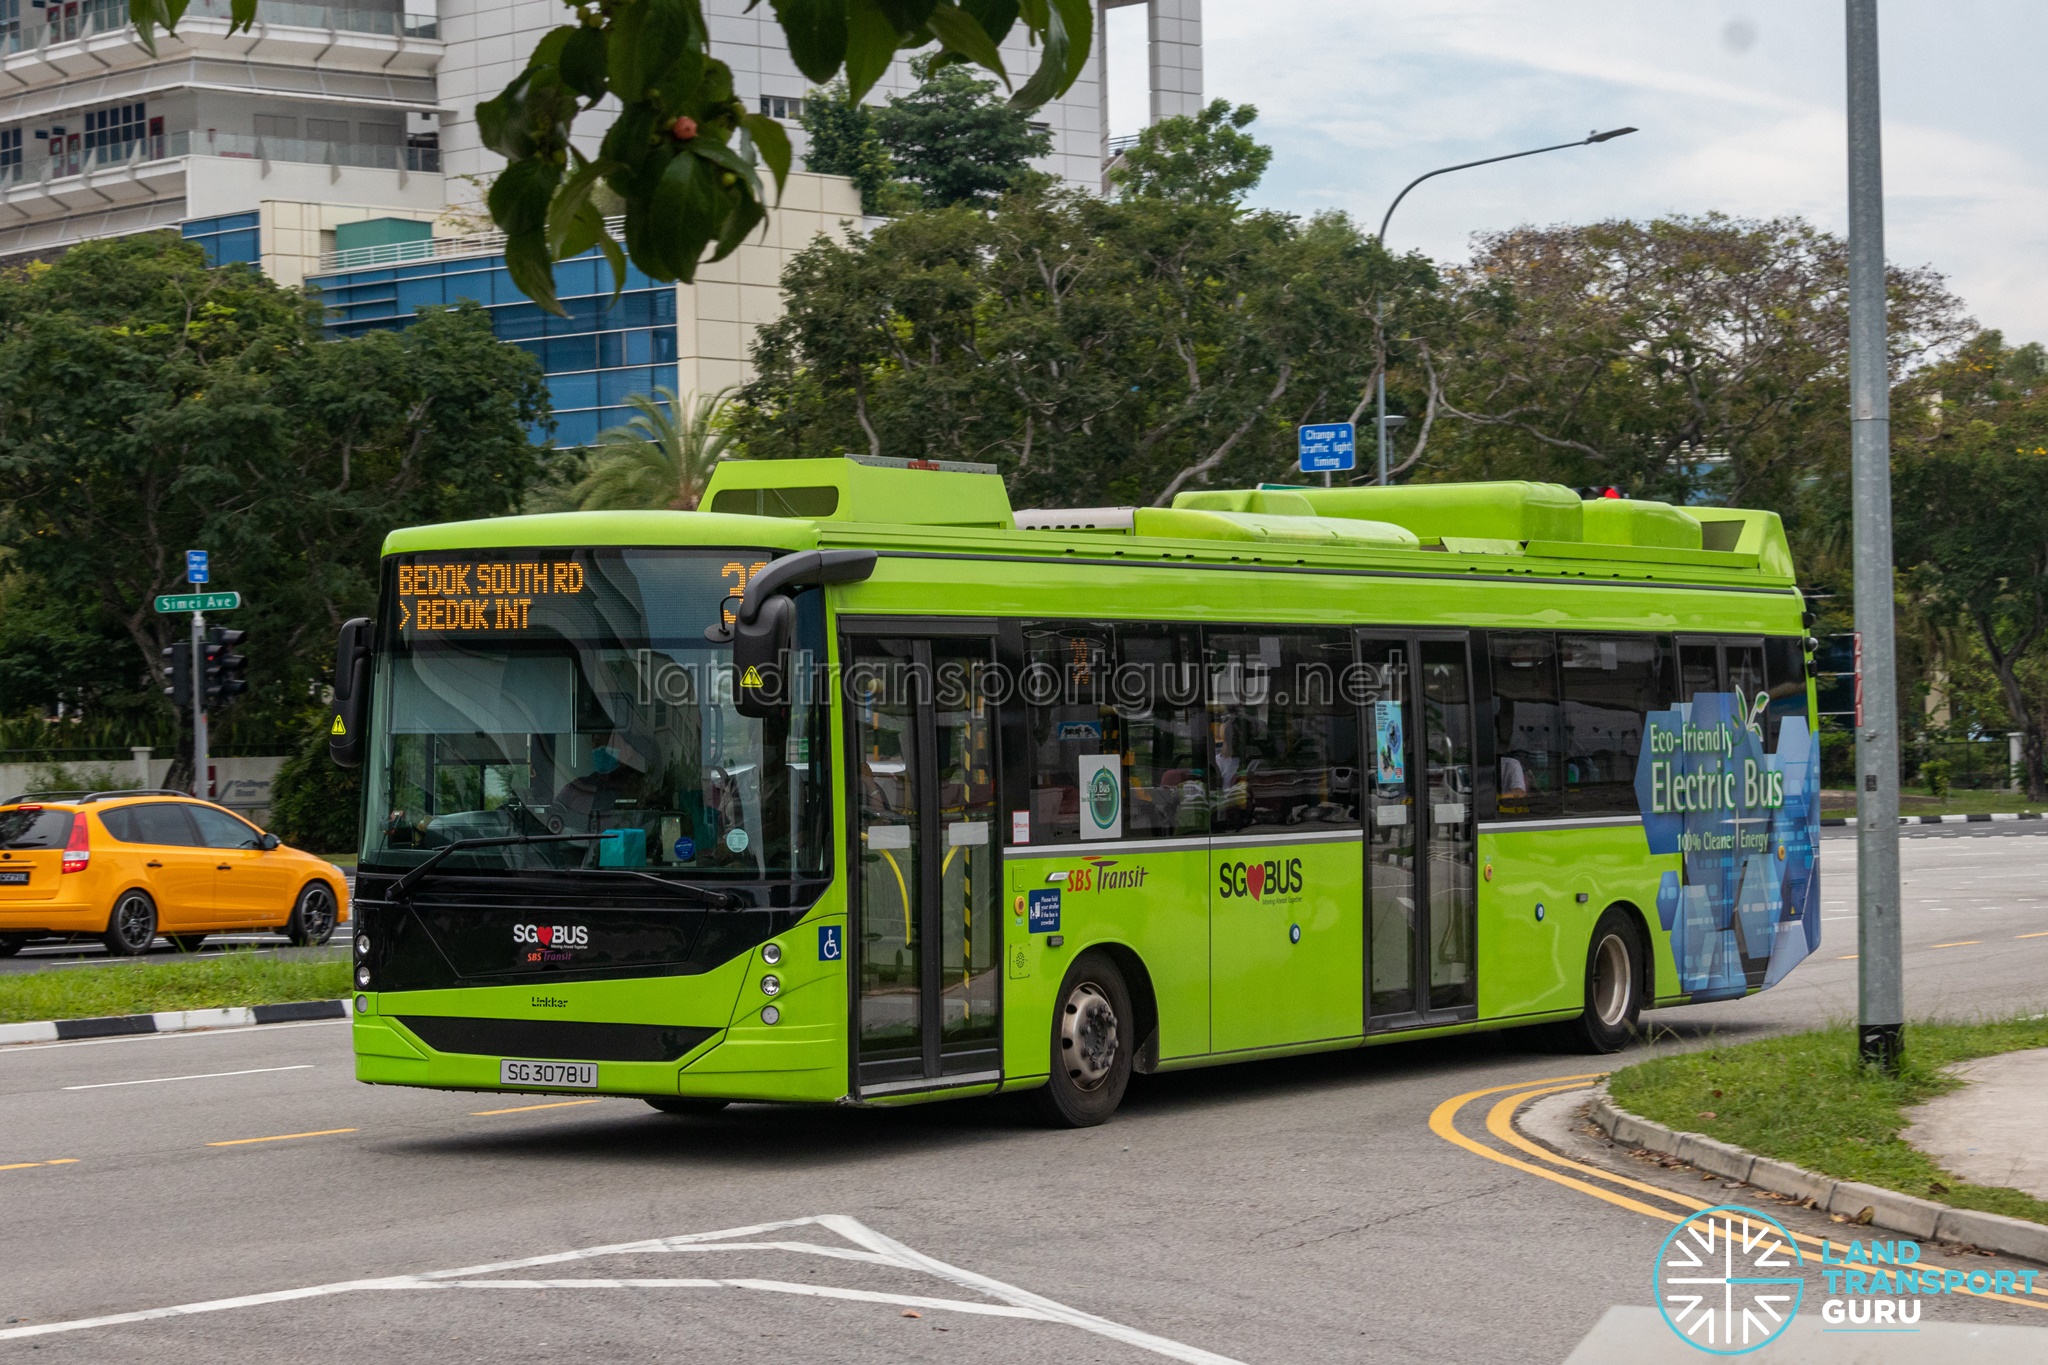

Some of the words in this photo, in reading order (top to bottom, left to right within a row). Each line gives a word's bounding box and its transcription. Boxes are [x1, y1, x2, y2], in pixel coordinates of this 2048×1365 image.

[1305, 429, 1335, 441] Change
[1339, 427, 1347, 438] in
[1301, 442, 1329, 454] traffic
[1333, 441, 1352, 454] light
[1314, 455, 1340, 468] timing
[400, 564, 471, 595] BEDOK
[477, 563, 548, 594] SOUTH
[554, 562, 583, 593] RD
[162, 597, 201, 610] Simei
[206, 596, 231, 608] Ave
[722, 562, 767, 624] 3
[417, 599, 489, 630] BEDOK
[495, 598, 531, 629] INT
[1650, 722, 1733, 758] Eco-friendly
[1652, 759, 1736, 813] Electric
[1744, 758, 1784, 808] Bus
[1677, 831, 1701, 851] 100%
[1703, 831, 1736, 850] Cleaner
[1740, 829, 1769, 851] Energy
[1067, 868, 1092, 892] SBS
[1090, 861, 1149, 894] Transit
[527, 953, 541, 962] SBS
[542, 950, 573, 962] Transit
[532, 997, 568, 1007] Linkker
[508, 1063, 591, 1083] SG3078U
